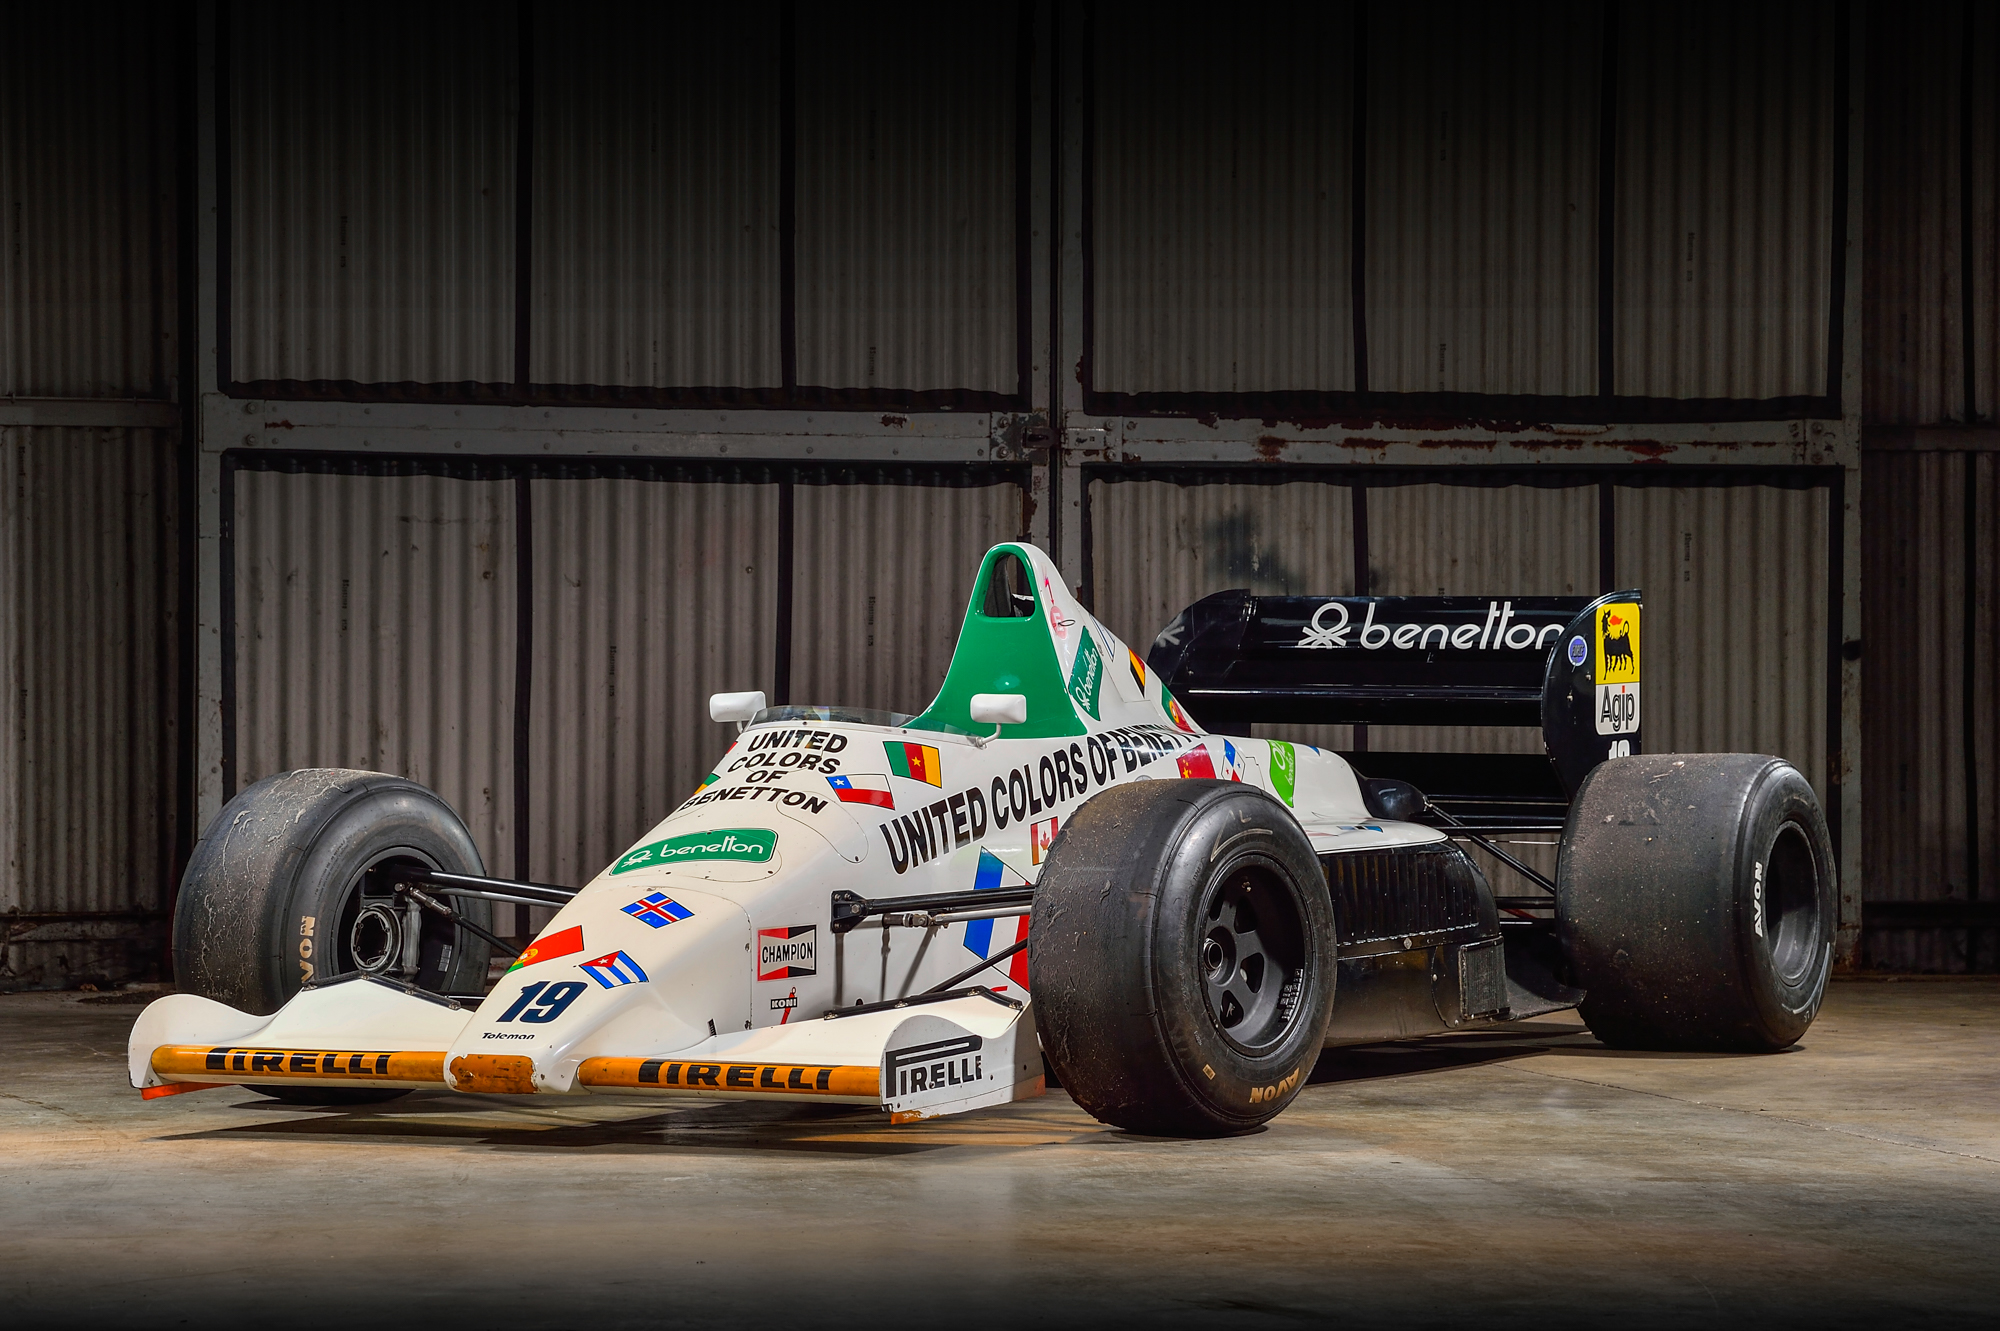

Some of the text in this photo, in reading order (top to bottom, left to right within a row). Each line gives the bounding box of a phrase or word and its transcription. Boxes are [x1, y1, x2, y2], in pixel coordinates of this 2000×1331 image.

[1600, 685, 1635, 732] Agip
[747, 729, 848, 753] UNITED
[727, 752, 841, 775] COLORS
[745, 770, 789, 784] OF
[676, 786, 828, 815] BENETTON
[879, 787, 987, 875] UNITED
[991, 743, 1088, 830] COLORS
[1086, 731, 1118, 787] OF
[659, 835, 764, 858] benetton
[1753, 861, 1763, 938] AVON
[761, 940, 814, 965] CHAMPION
[496, 980, 589, 1024] 19
[771, 998, 797, 1009] KONI
[482, 1031, 535, 1041] Toleman
[884, 1034, 984, 1099] PIRELLI
[1249, 1066, 1300, 1104] AVON
